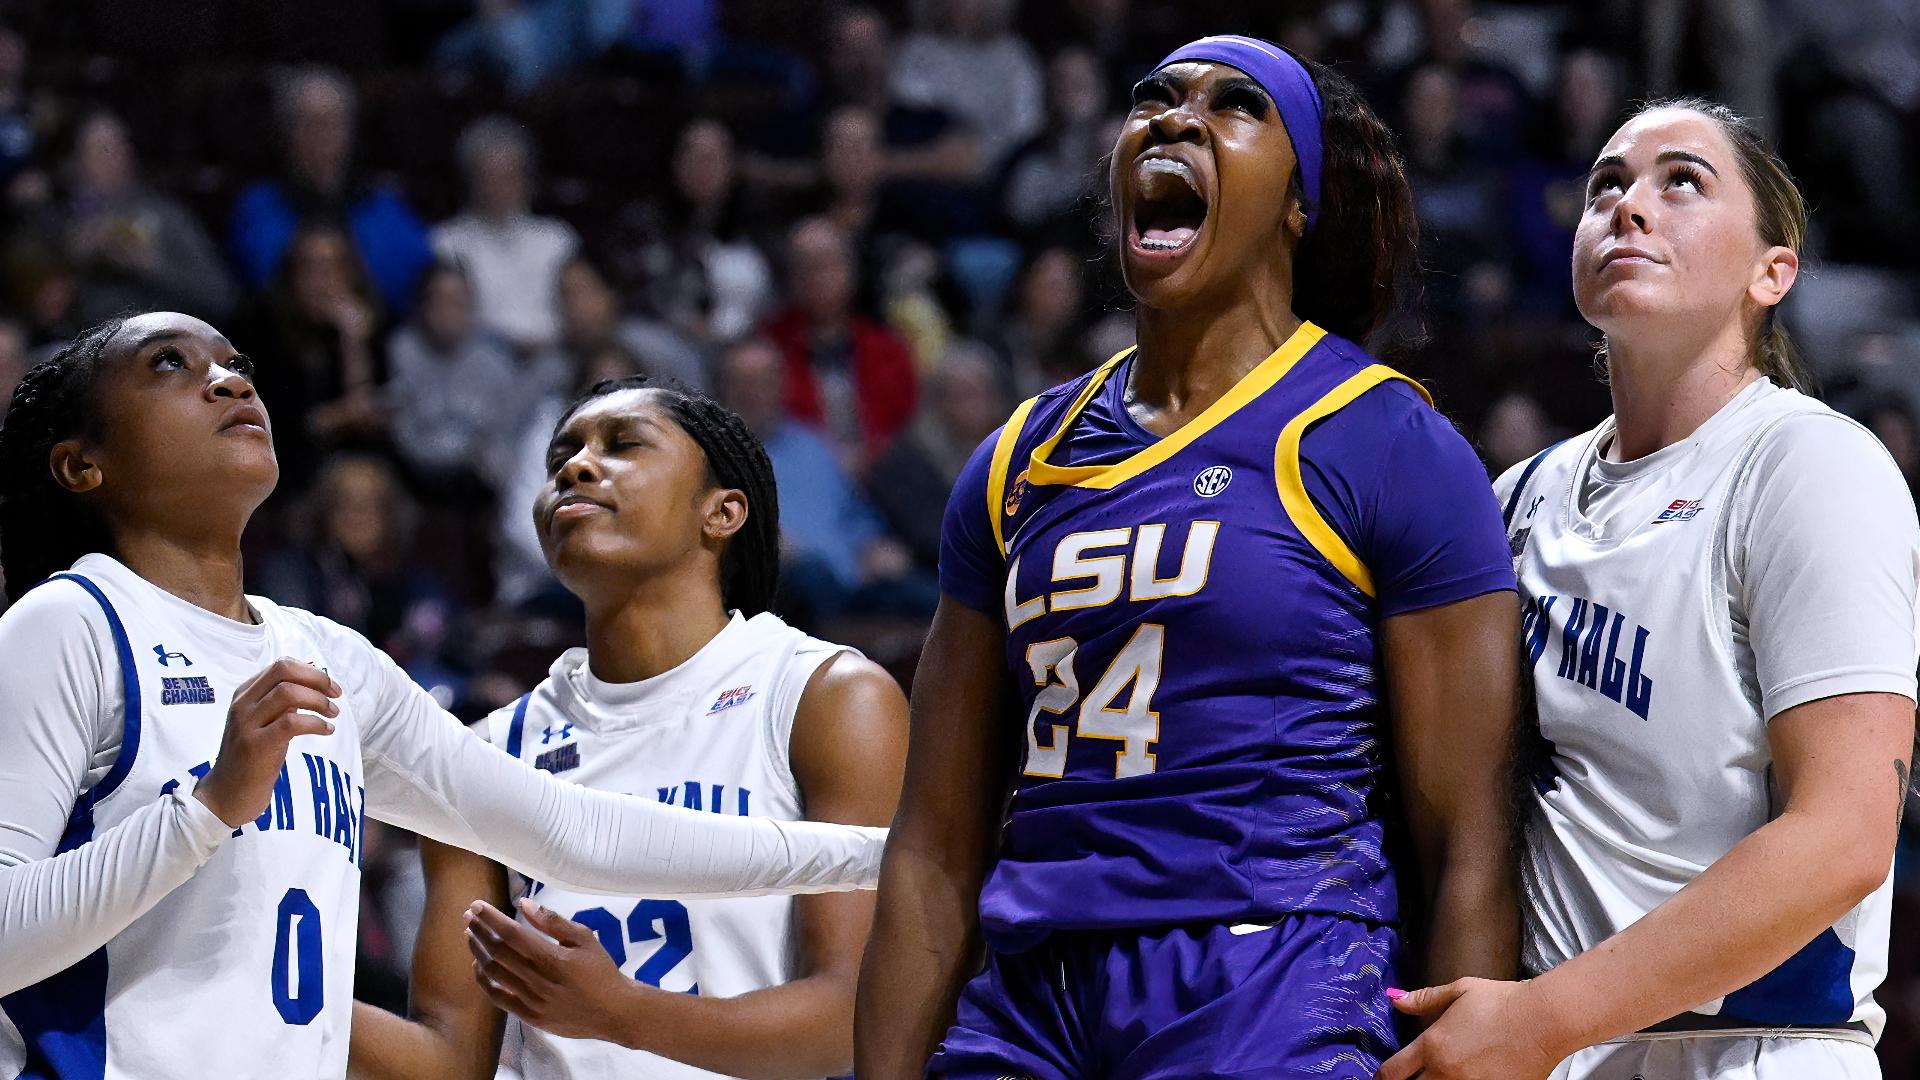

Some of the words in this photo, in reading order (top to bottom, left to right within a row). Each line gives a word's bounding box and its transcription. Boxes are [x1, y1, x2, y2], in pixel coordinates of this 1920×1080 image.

[1196, 468, 1230, 495] SEC
[1657, 507, 1705, 520] EAST
[1667, 499, 1703, 510] BIG
[1004, 520, 1221, 633] LSU
[1557, 597, 1653, 722] HALL
[162, 677, 181, 690] BE
[183, 676, 209, 689] THE
[162, 688, 216, 705] CHANGE
[710, 692, 757, 711] EAST
[718, 685, 752, 701] BIG
[1022, 622, 1166, 780] 24
[271, 887, 324, 1026] 0
